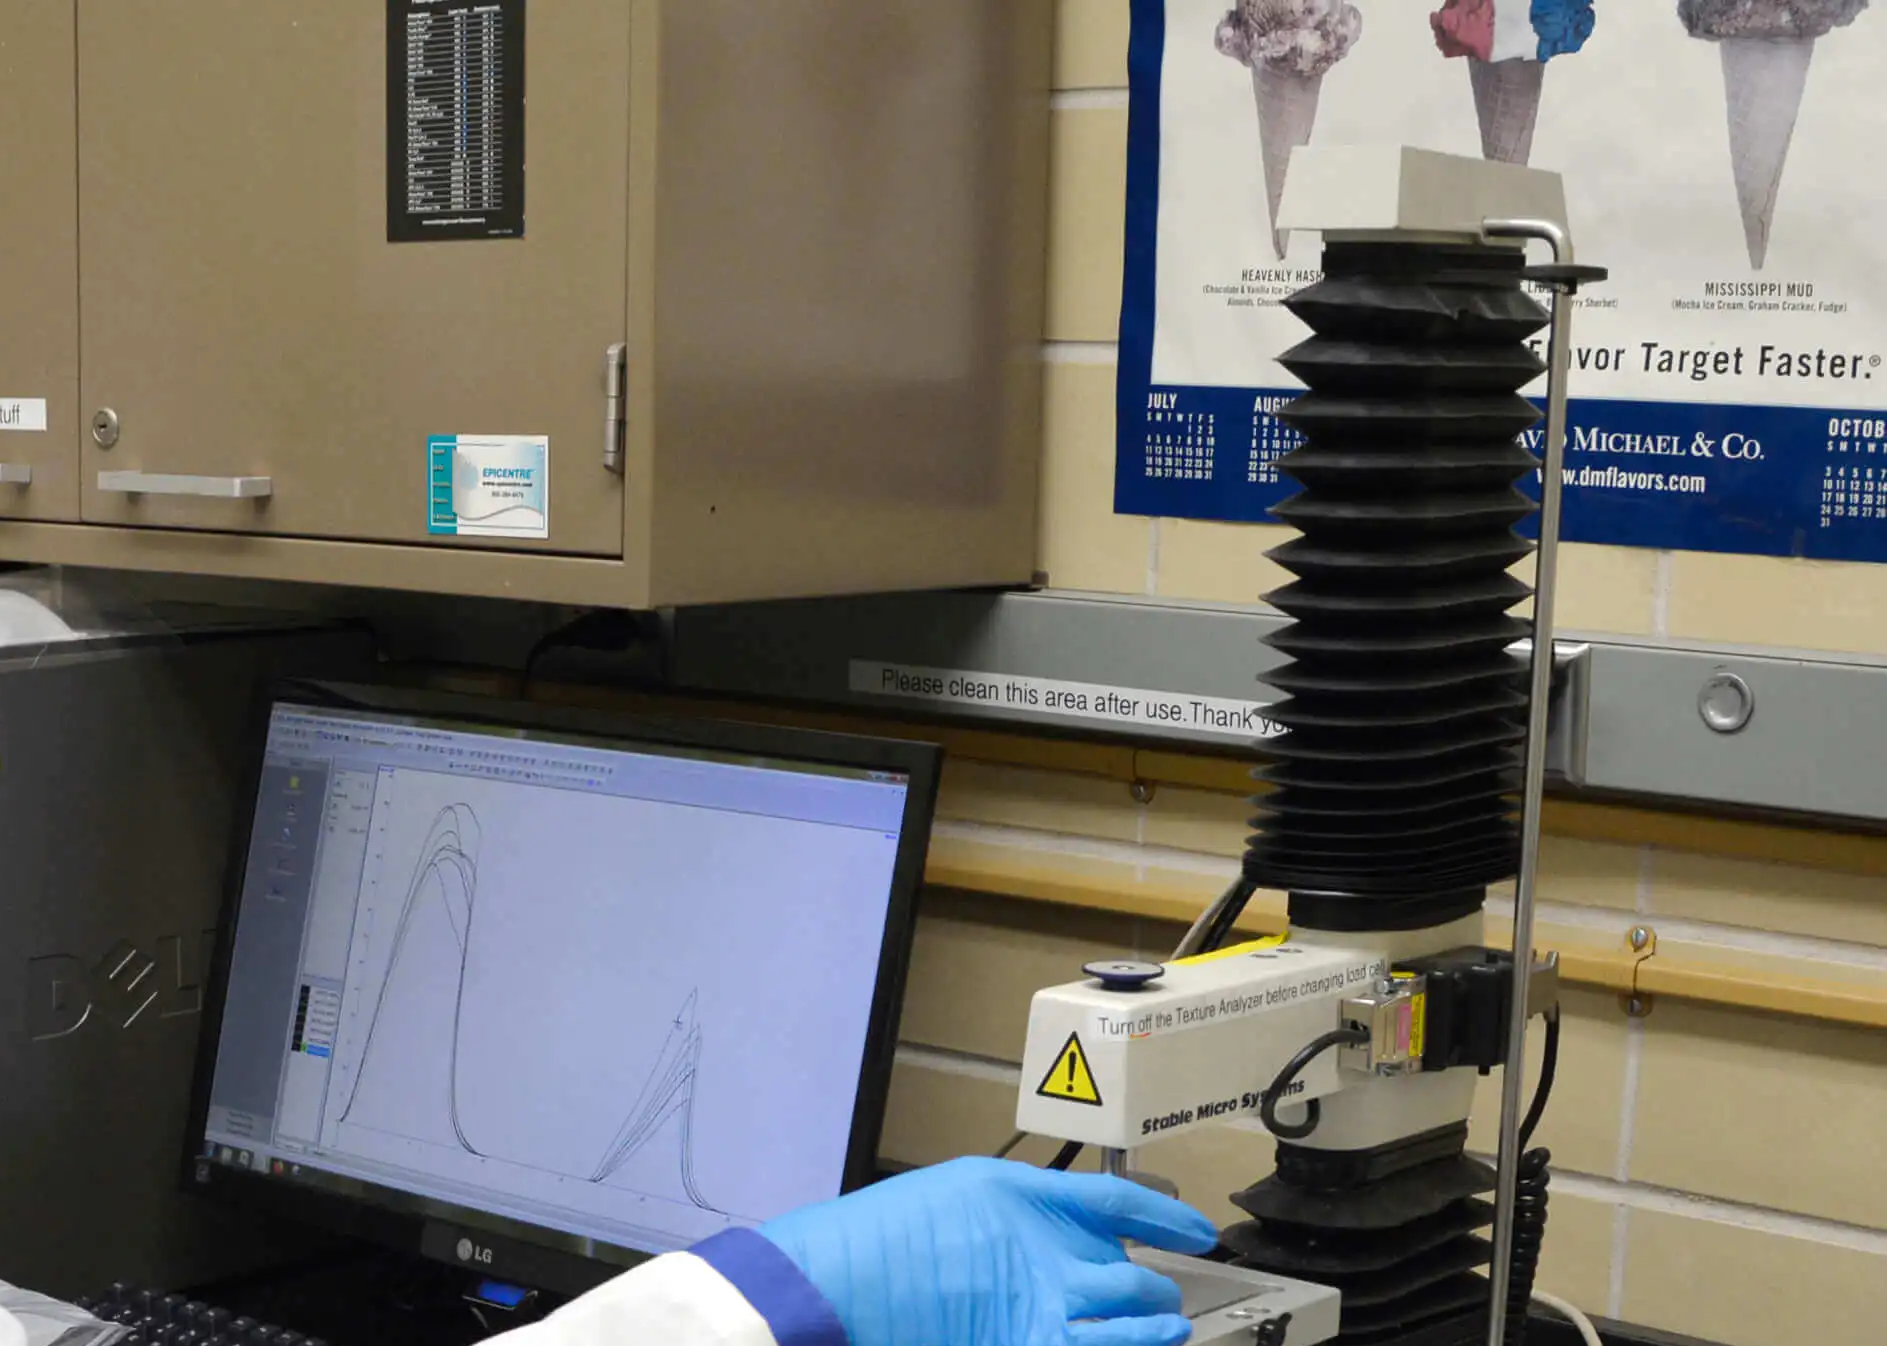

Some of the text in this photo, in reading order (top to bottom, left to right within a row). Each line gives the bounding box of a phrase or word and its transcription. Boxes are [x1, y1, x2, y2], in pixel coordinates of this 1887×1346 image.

[1241, 269, 1323, 282] HEAVENLY HASH
[1705, 282, 1814, 297] MISSISSIPPI MUD
[1641, 342, 1742, 381] Target
[1147, 393, 1178, 409] JULY
[1691, 431, 1715, 457] &
[882, 668, 944, 696] Please
[948, 676, 999, 701] clean
[1005, 681, 1038, 705] this
[1044, 688, 1088, 711] area
[1094, 693, 1139, 718] after
[1097, 1016, 1134, 1036] Turn
[1138, 1013, 1152, 1033] off
[1155, 1012, 1172, 1028] the
[1175, 1004, 1216, 1025] Texture
[1219, 991, 1264, 1015] Analyzer
[1265, 982, 1298, 1004] before
[1300, 972, 1344, 998] changing
[1346, 963, 1366, 984] load
[1142, 1108, 1192, 1135] Stable
[1196, 1098, 1237, 1121] Micro
[474, 1244, 492, 1264] LG
